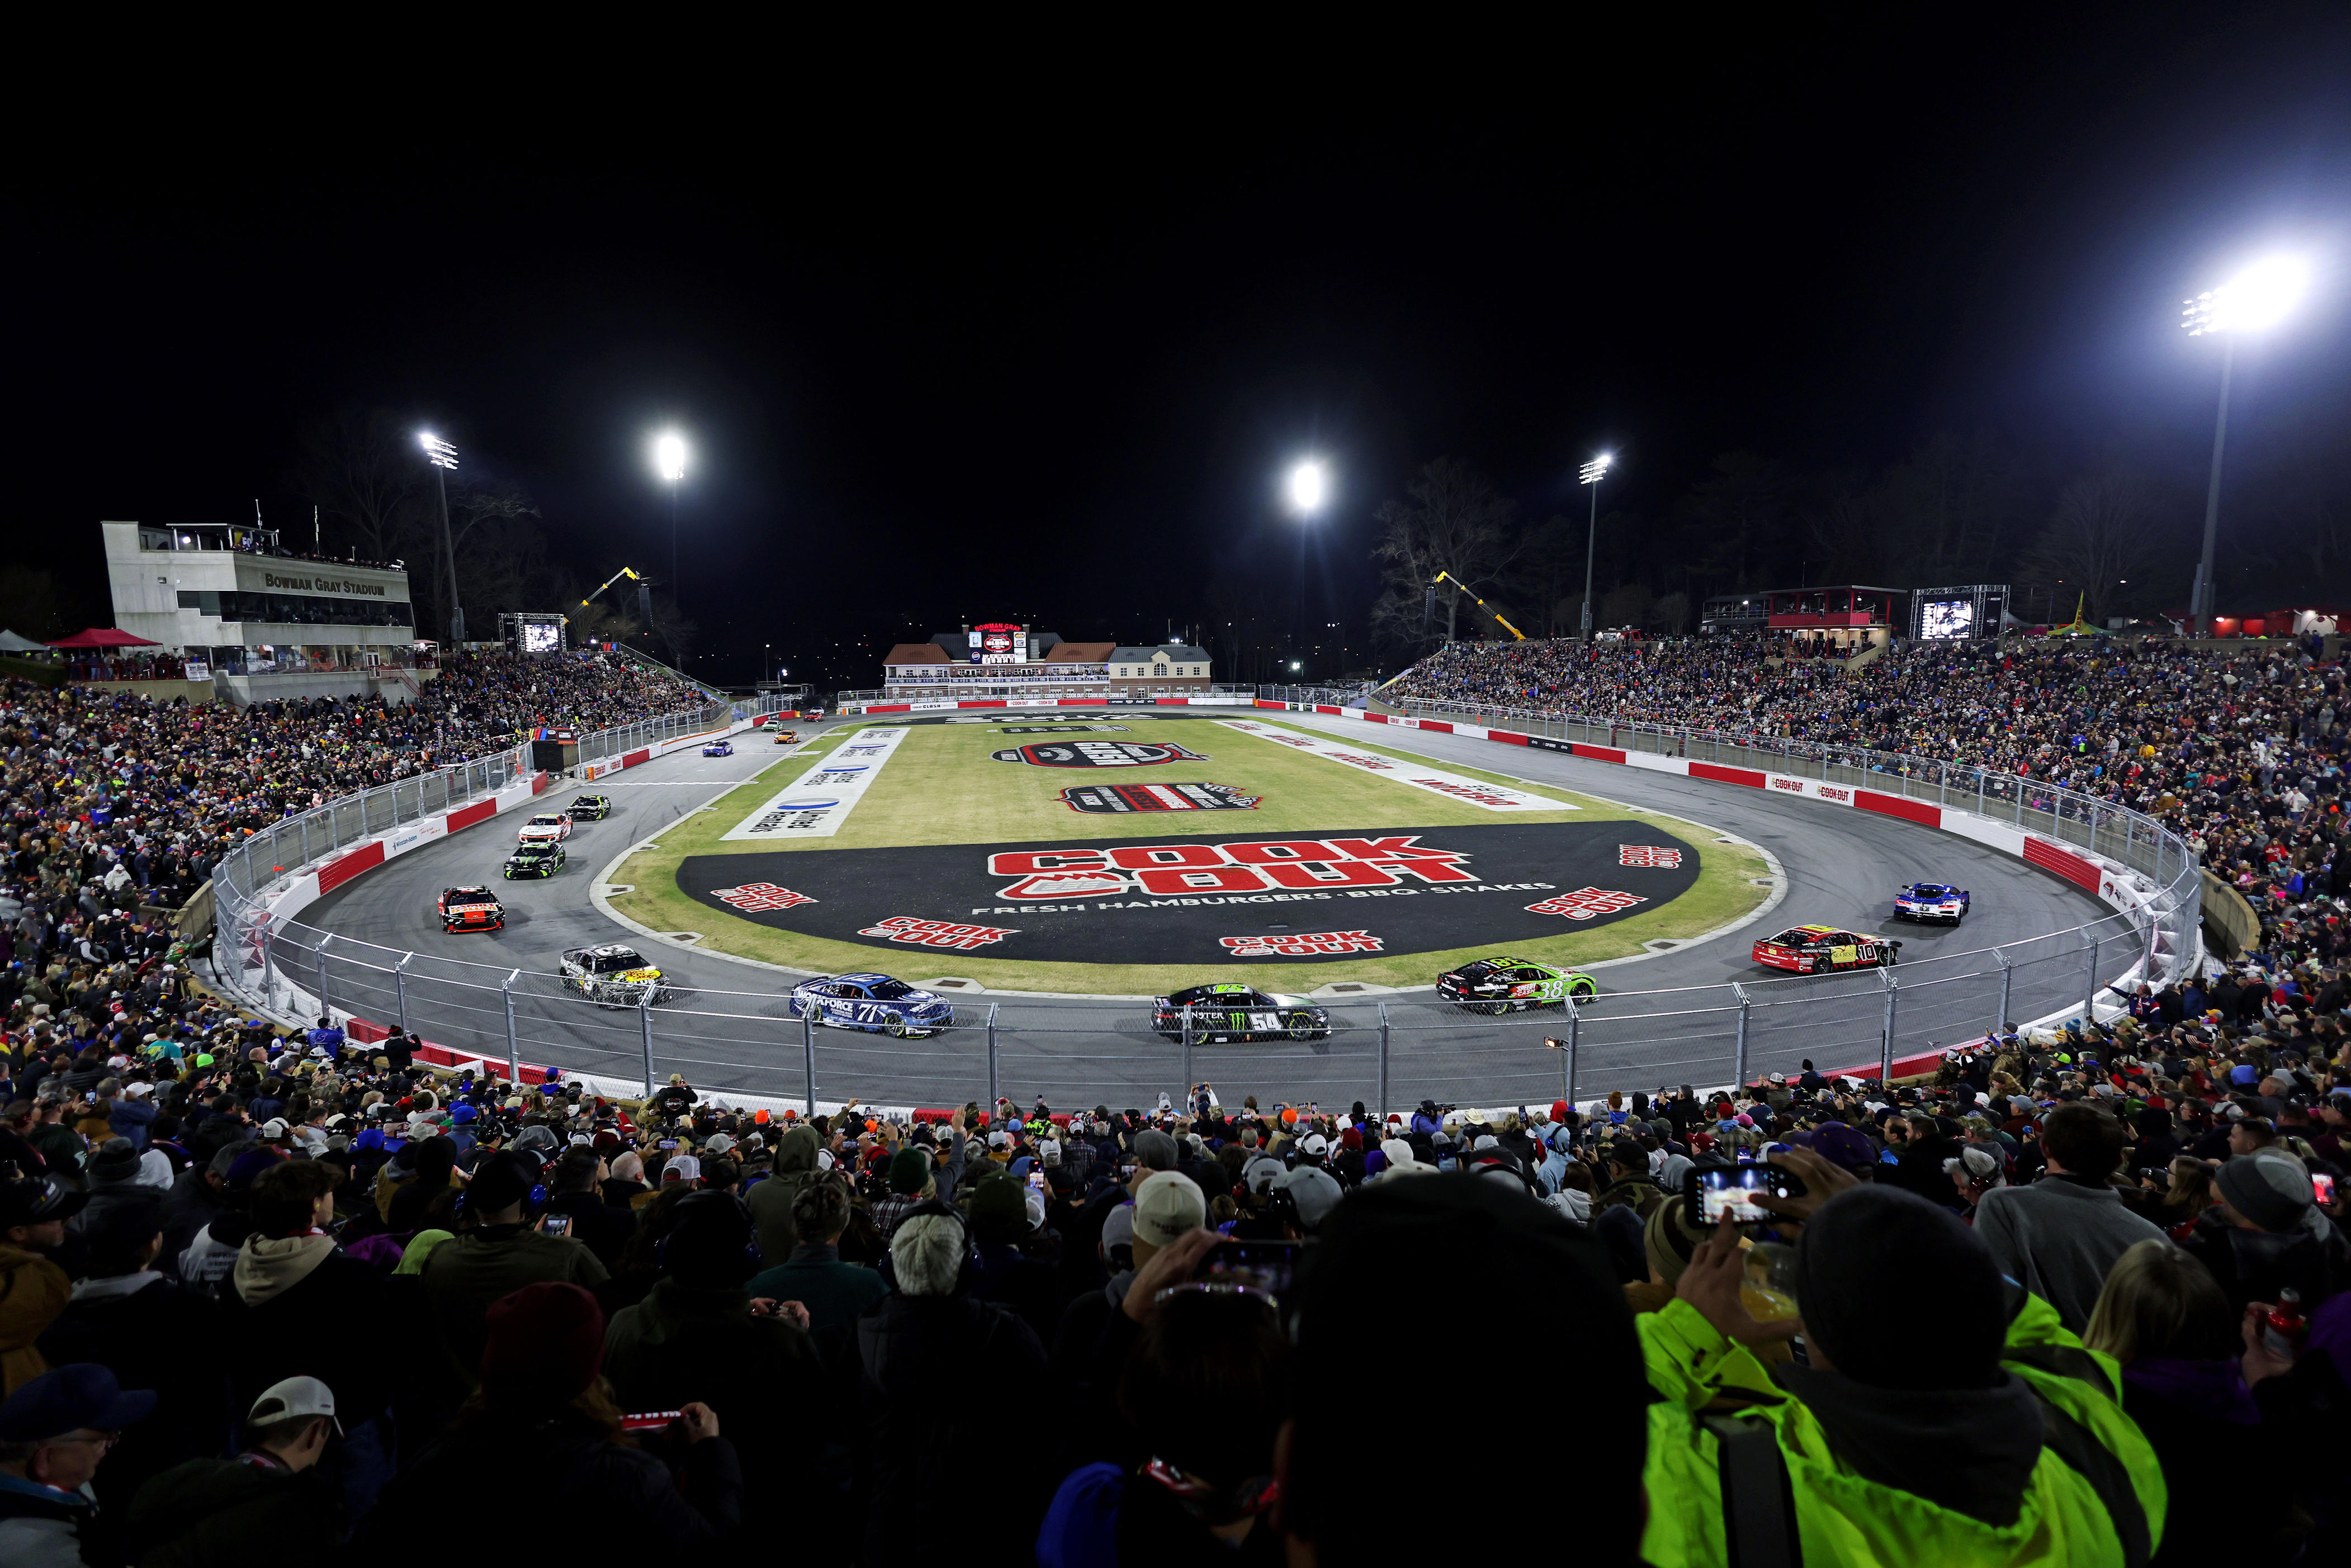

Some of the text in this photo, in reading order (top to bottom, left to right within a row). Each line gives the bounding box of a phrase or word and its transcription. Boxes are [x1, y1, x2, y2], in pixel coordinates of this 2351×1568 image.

[265, 574, 385, 595] BOWMAN GRAY STADIUM
[975, 623, 1003, 632] BOWMAN
[1073, 742, 1139, 765] CLASH
[1321, 752, 1395, 769] DISCOUNT
[804, 773, 838, 785] Rentals
[833, 772, 863, 783] United
[1776, 779, 1803, 792] COOK OUT
[1118, 786, 1163, 809] CLASSIC
[1143, 785, 1192, 809] MADHOUSE
[1408, 779, 1521, 805] DISCOUNT
[1465, 784, 1515, 796] TIRE
[1821, 787, 1849, 801] COOK OUT
[748, 811, 797, 832] Rentals
[787, 810, 831, 829] United
[396, 835, 418, 847] Winston-Salem
[987, 835, 1474, 877] COOK
[1619, 844, 1650, 867] COOK
[1651, 846, 1682, 863] OUT
[1132, 855, 1482, 896] OUT
[720, 894, 783, 913] OUT
[736, 882, 820, 908] COOK
[972, 883, 1556, 915] FRESH HAMBURGERS BBQ SHAKES
[1524, 886, 1620, 915] COOK
[1580, 891, 1649, 913] OUT
[876, 916, 1023, 941] COOK
[888, 931, 996, 950] OUT
[1219, 930, 1384, 948] COOK
[1275, 939, 1384, 955] OUT
[1858, 944, 1877, 961] 10
[1516, 982, 1536, 992] SPEEDY
[1517, 988, 1535, 996] CASH
[1538, 980, 1564, 998] 38
[857, 1003, 879, 1022] 71
[1175, 1011, 1224, 1020] MNSTER
[1248, 1012, 1283, 1031] 54
[317, 1034, 328, 1042] 5
